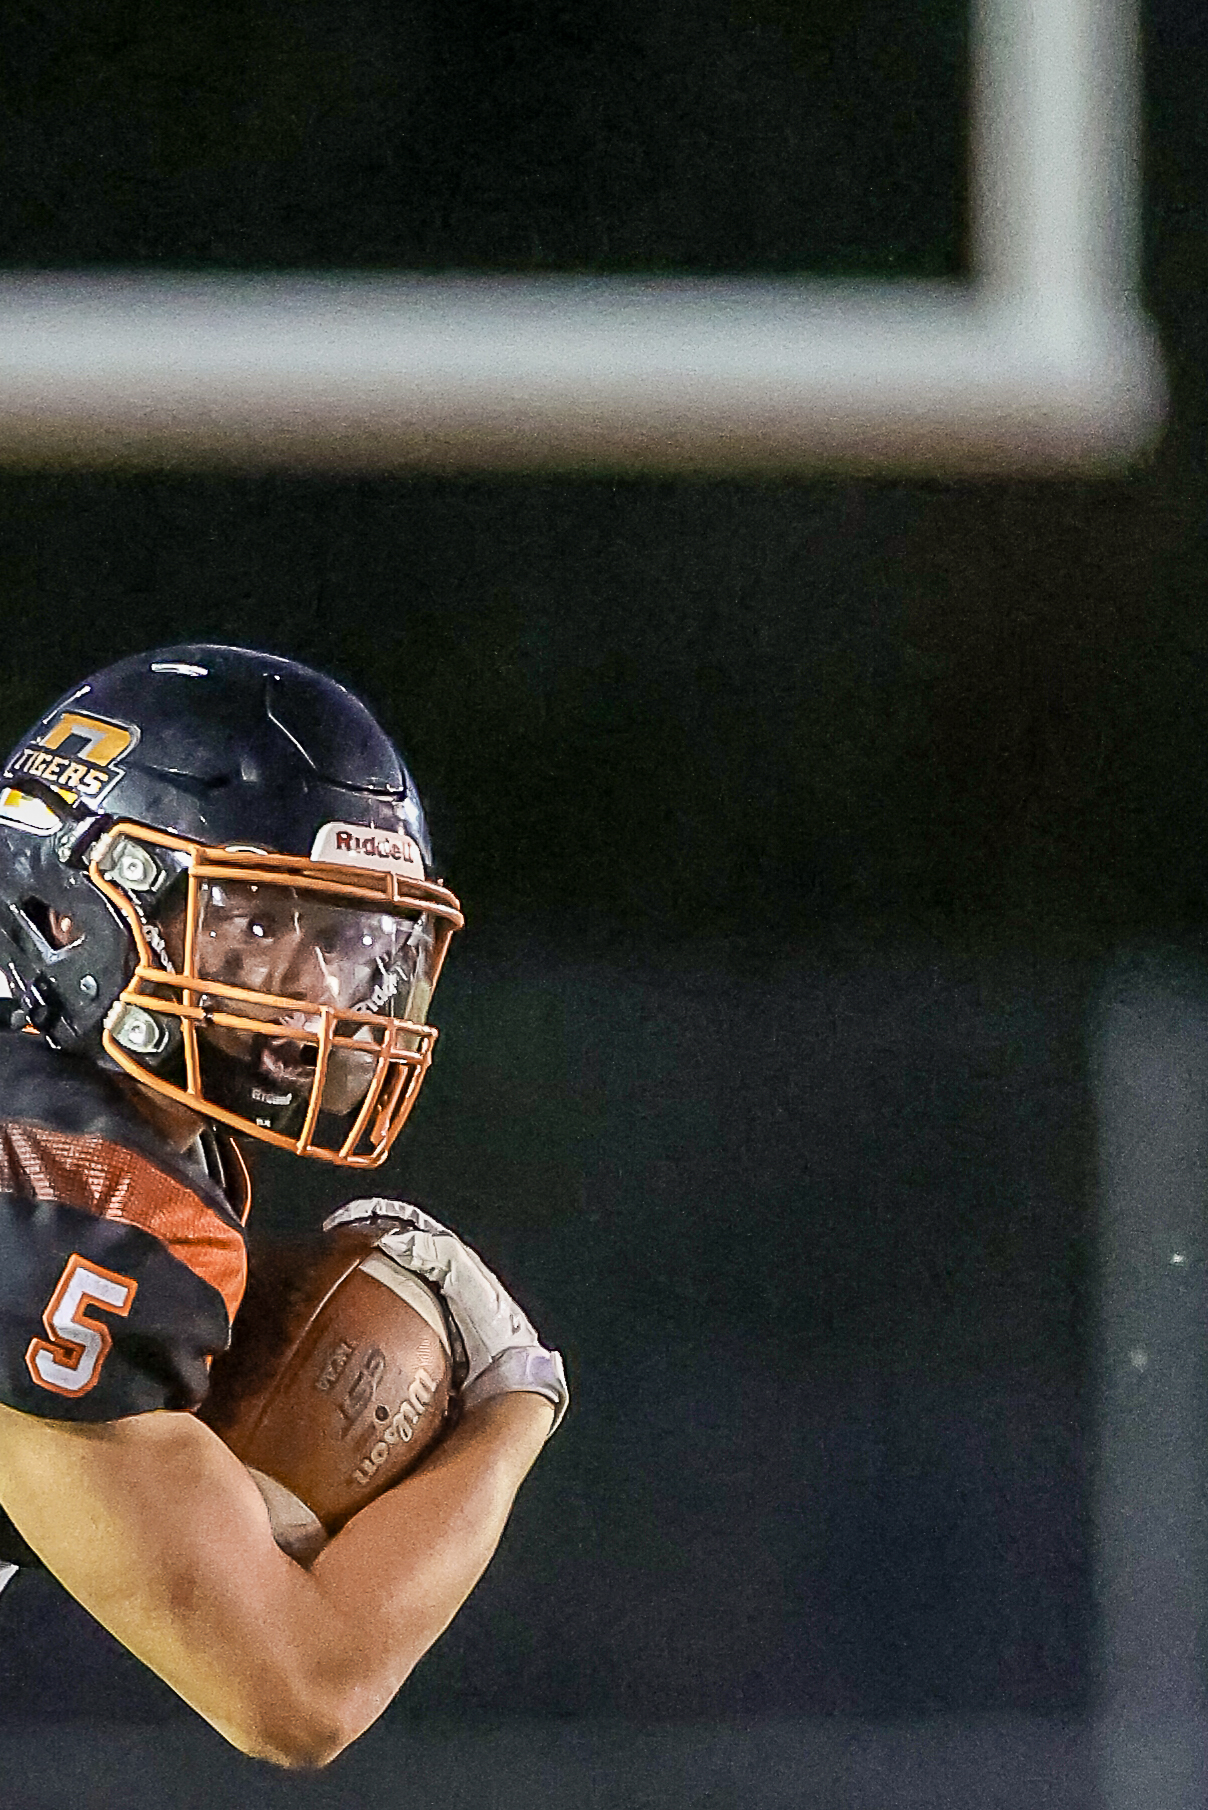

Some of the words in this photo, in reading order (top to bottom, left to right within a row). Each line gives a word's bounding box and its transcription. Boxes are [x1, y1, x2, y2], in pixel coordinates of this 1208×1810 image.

[14, 748, 109, 795] TIGERS
[336, 831, 414, 863] Riddell
[25, 1252, 139, 1398] 5
[352, 1368, 438, 1485] Wilson
